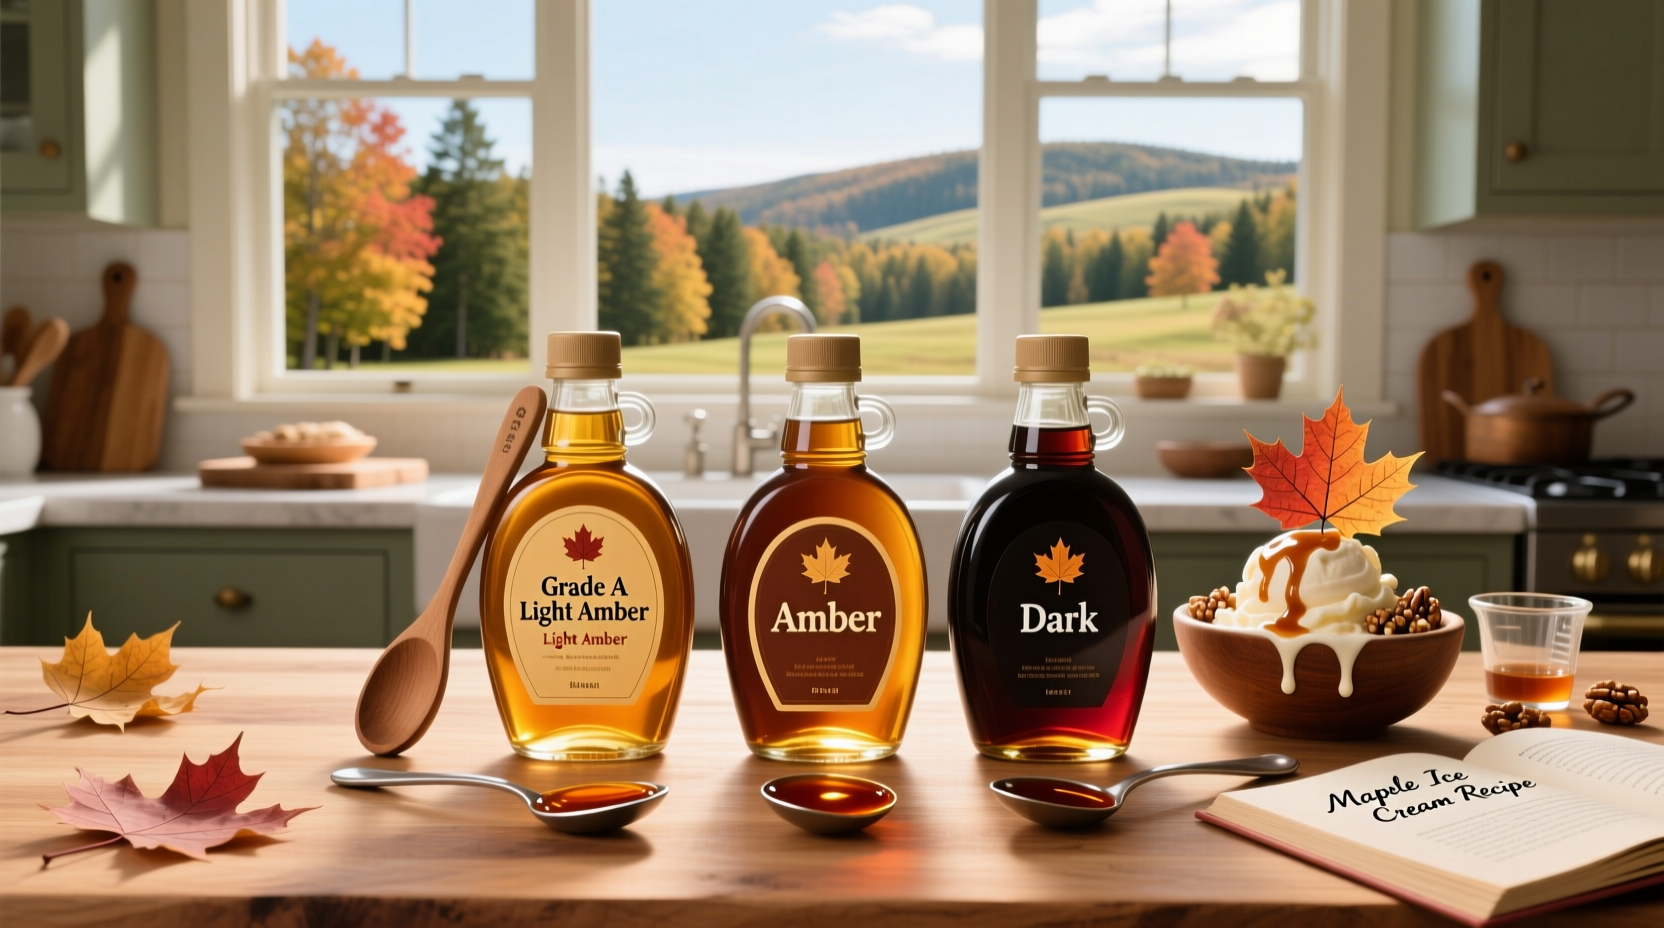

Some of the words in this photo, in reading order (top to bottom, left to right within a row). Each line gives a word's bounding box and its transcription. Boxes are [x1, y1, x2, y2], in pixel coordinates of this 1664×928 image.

[541, 575, 606, 597] Grade
[610, 576, 629, 597] A
[520, 600, 573, 627] Light
[577, 600, 650, 622] Amber
[770, 600, 882, 633] Amber
[1020, 601, 1099, 633] Dark
[543, 631, 577, 650] Light
[581, 631, 628, 646] Amber
[1423, 769, 1468, 787] Ice
[1373, 797, 1455, 822] Cream
[1454, 780, 1537, 801] Recipe
